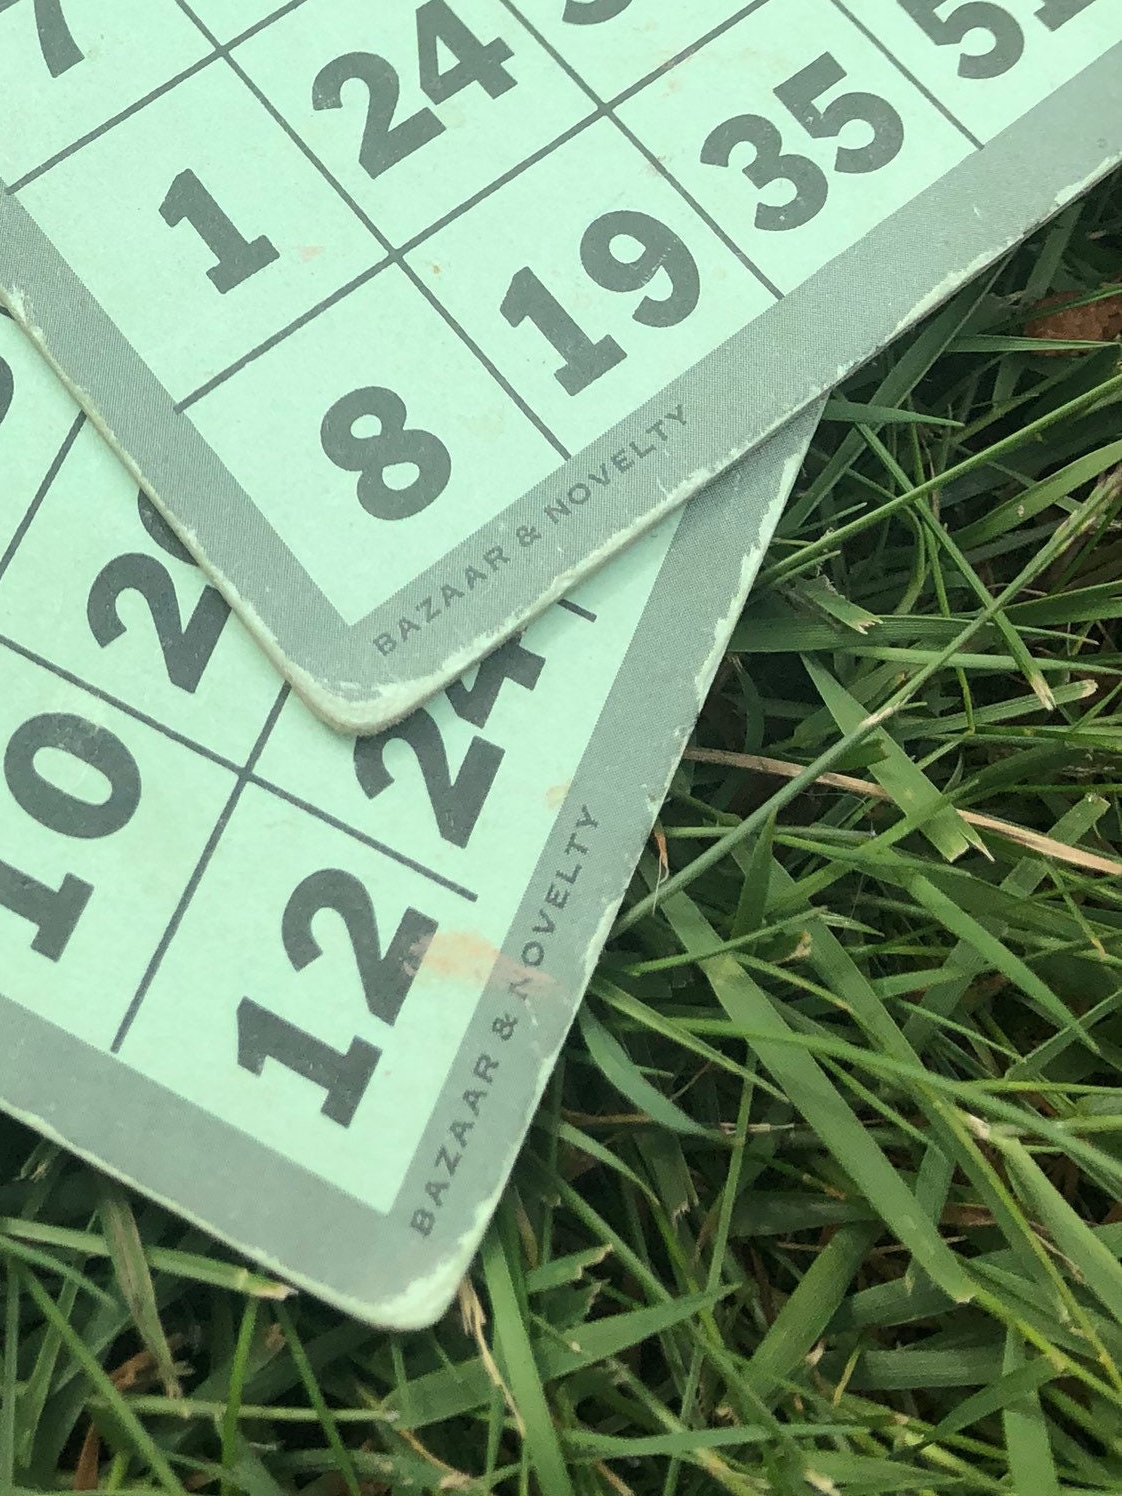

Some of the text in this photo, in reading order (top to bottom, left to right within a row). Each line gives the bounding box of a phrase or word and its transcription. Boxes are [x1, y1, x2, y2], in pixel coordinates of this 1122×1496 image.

[159, 169, 280, 294] 1
[320, 386, 451, 521] 8
[500, 210, 700, 396] 19
[700, 51, 904, 231] 35
[372, 404, 688, 656] BAZAAR & NOVELTY
[237, 869, 438, 1128] 12
[410, 804, 599, 1237] BAZAAR & NOVELTY
